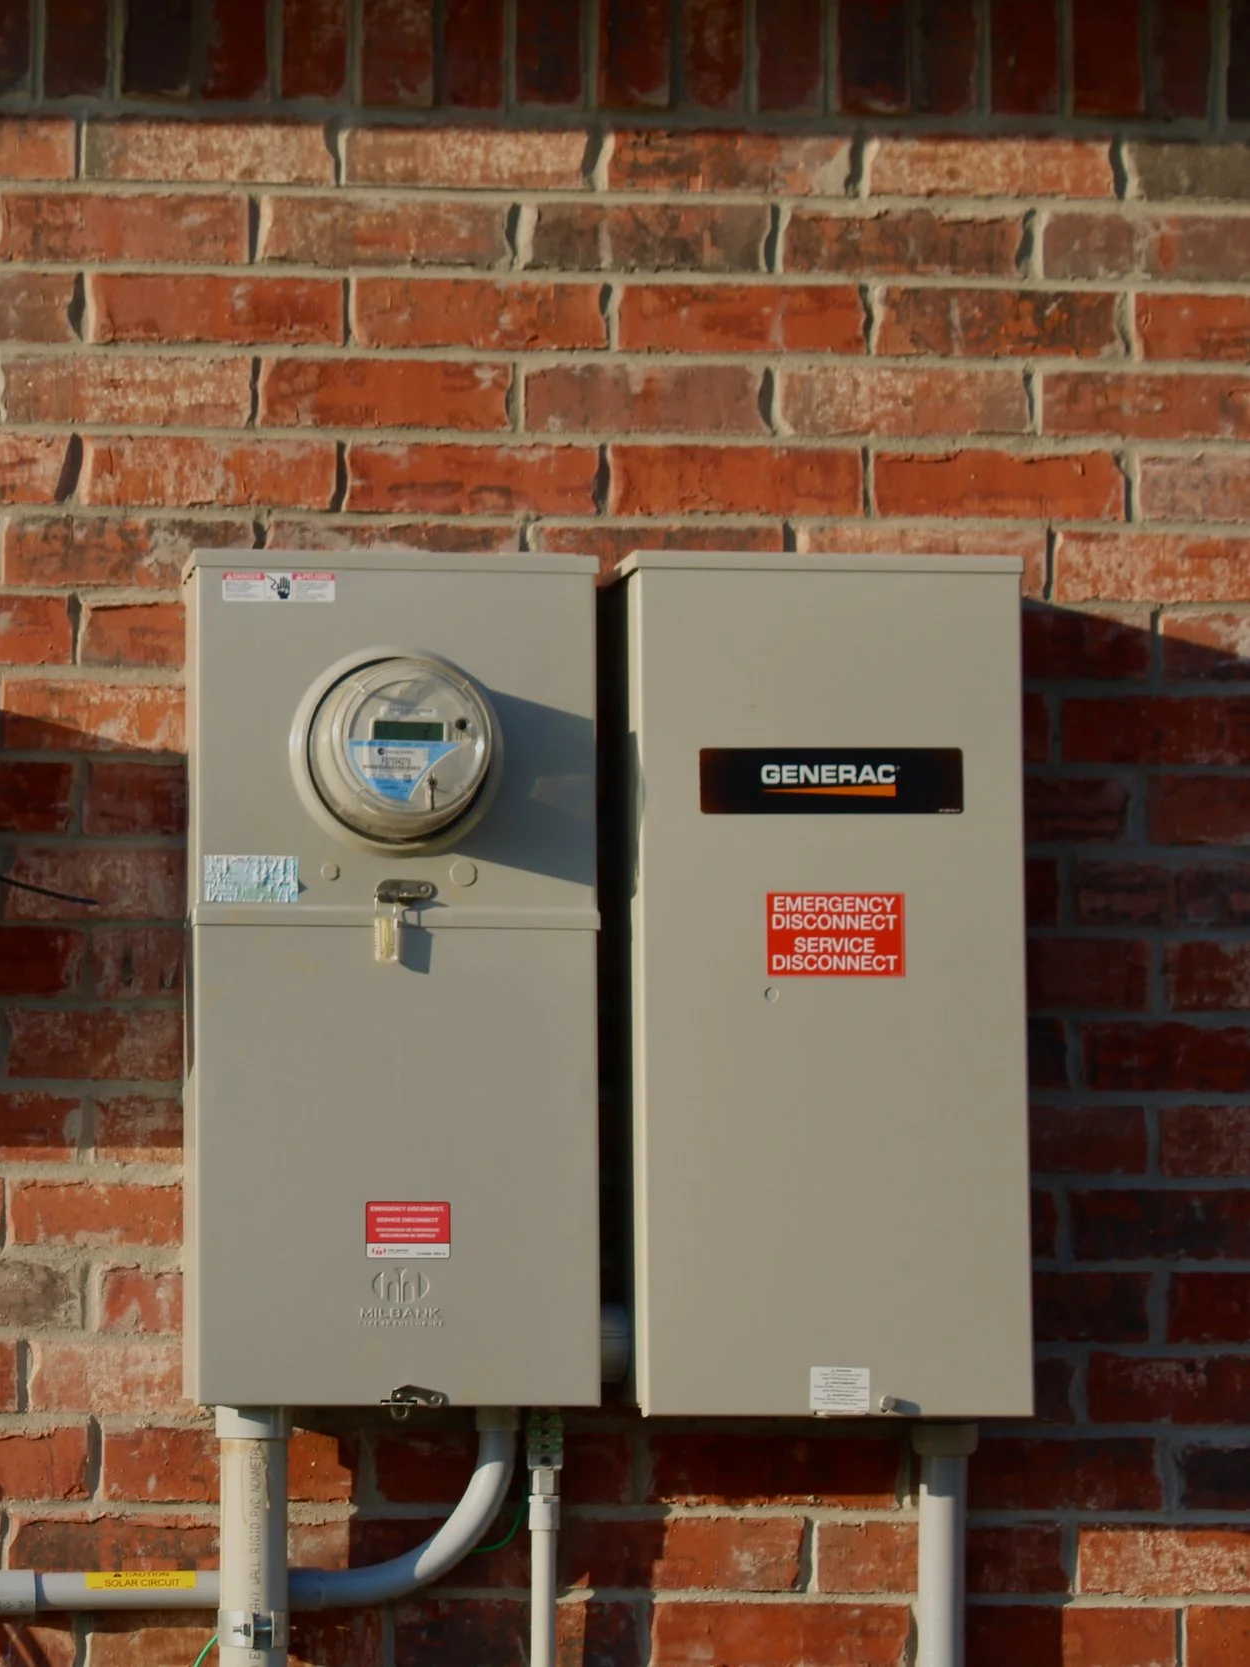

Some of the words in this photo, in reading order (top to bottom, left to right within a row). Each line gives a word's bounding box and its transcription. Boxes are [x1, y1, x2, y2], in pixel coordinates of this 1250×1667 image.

[761, 764, 896, 784] GENERAC
[773, 896, 896, 913] EMERGENCY
[772, 914, 897, 930] DISCONNECT
[794, 937, 876, 953] SERVICE
[772, 955, 898, 971] DISCONNECT
[360, 1307, 442, 1319] MILBANK
[104, 1579, 138, 1587] SOLAR
[140, 1579, 180, 1587] CIRCUIT
